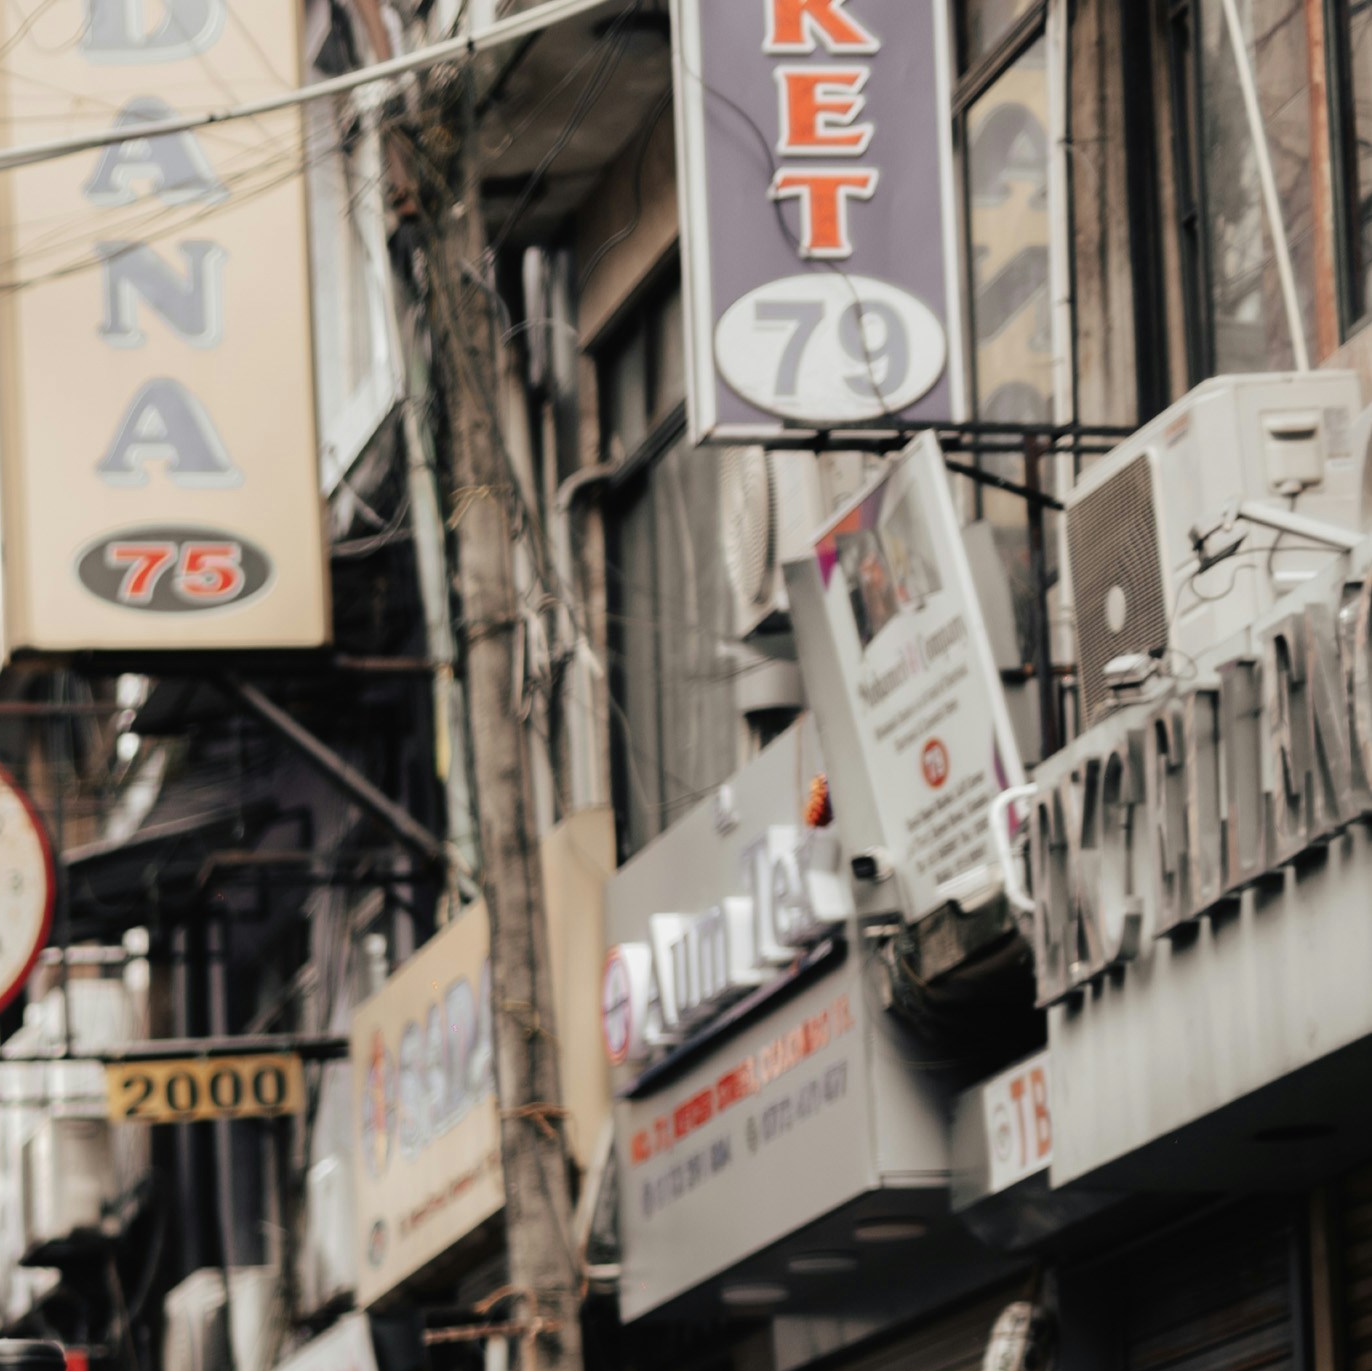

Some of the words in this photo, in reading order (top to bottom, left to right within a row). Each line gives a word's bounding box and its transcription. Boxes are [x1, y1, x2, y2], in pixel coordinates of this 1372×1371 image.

[752, 297, 912, 402] 79
[104, 541, 245, 604] 75
[121, 1065, 289, 1117] 2000
